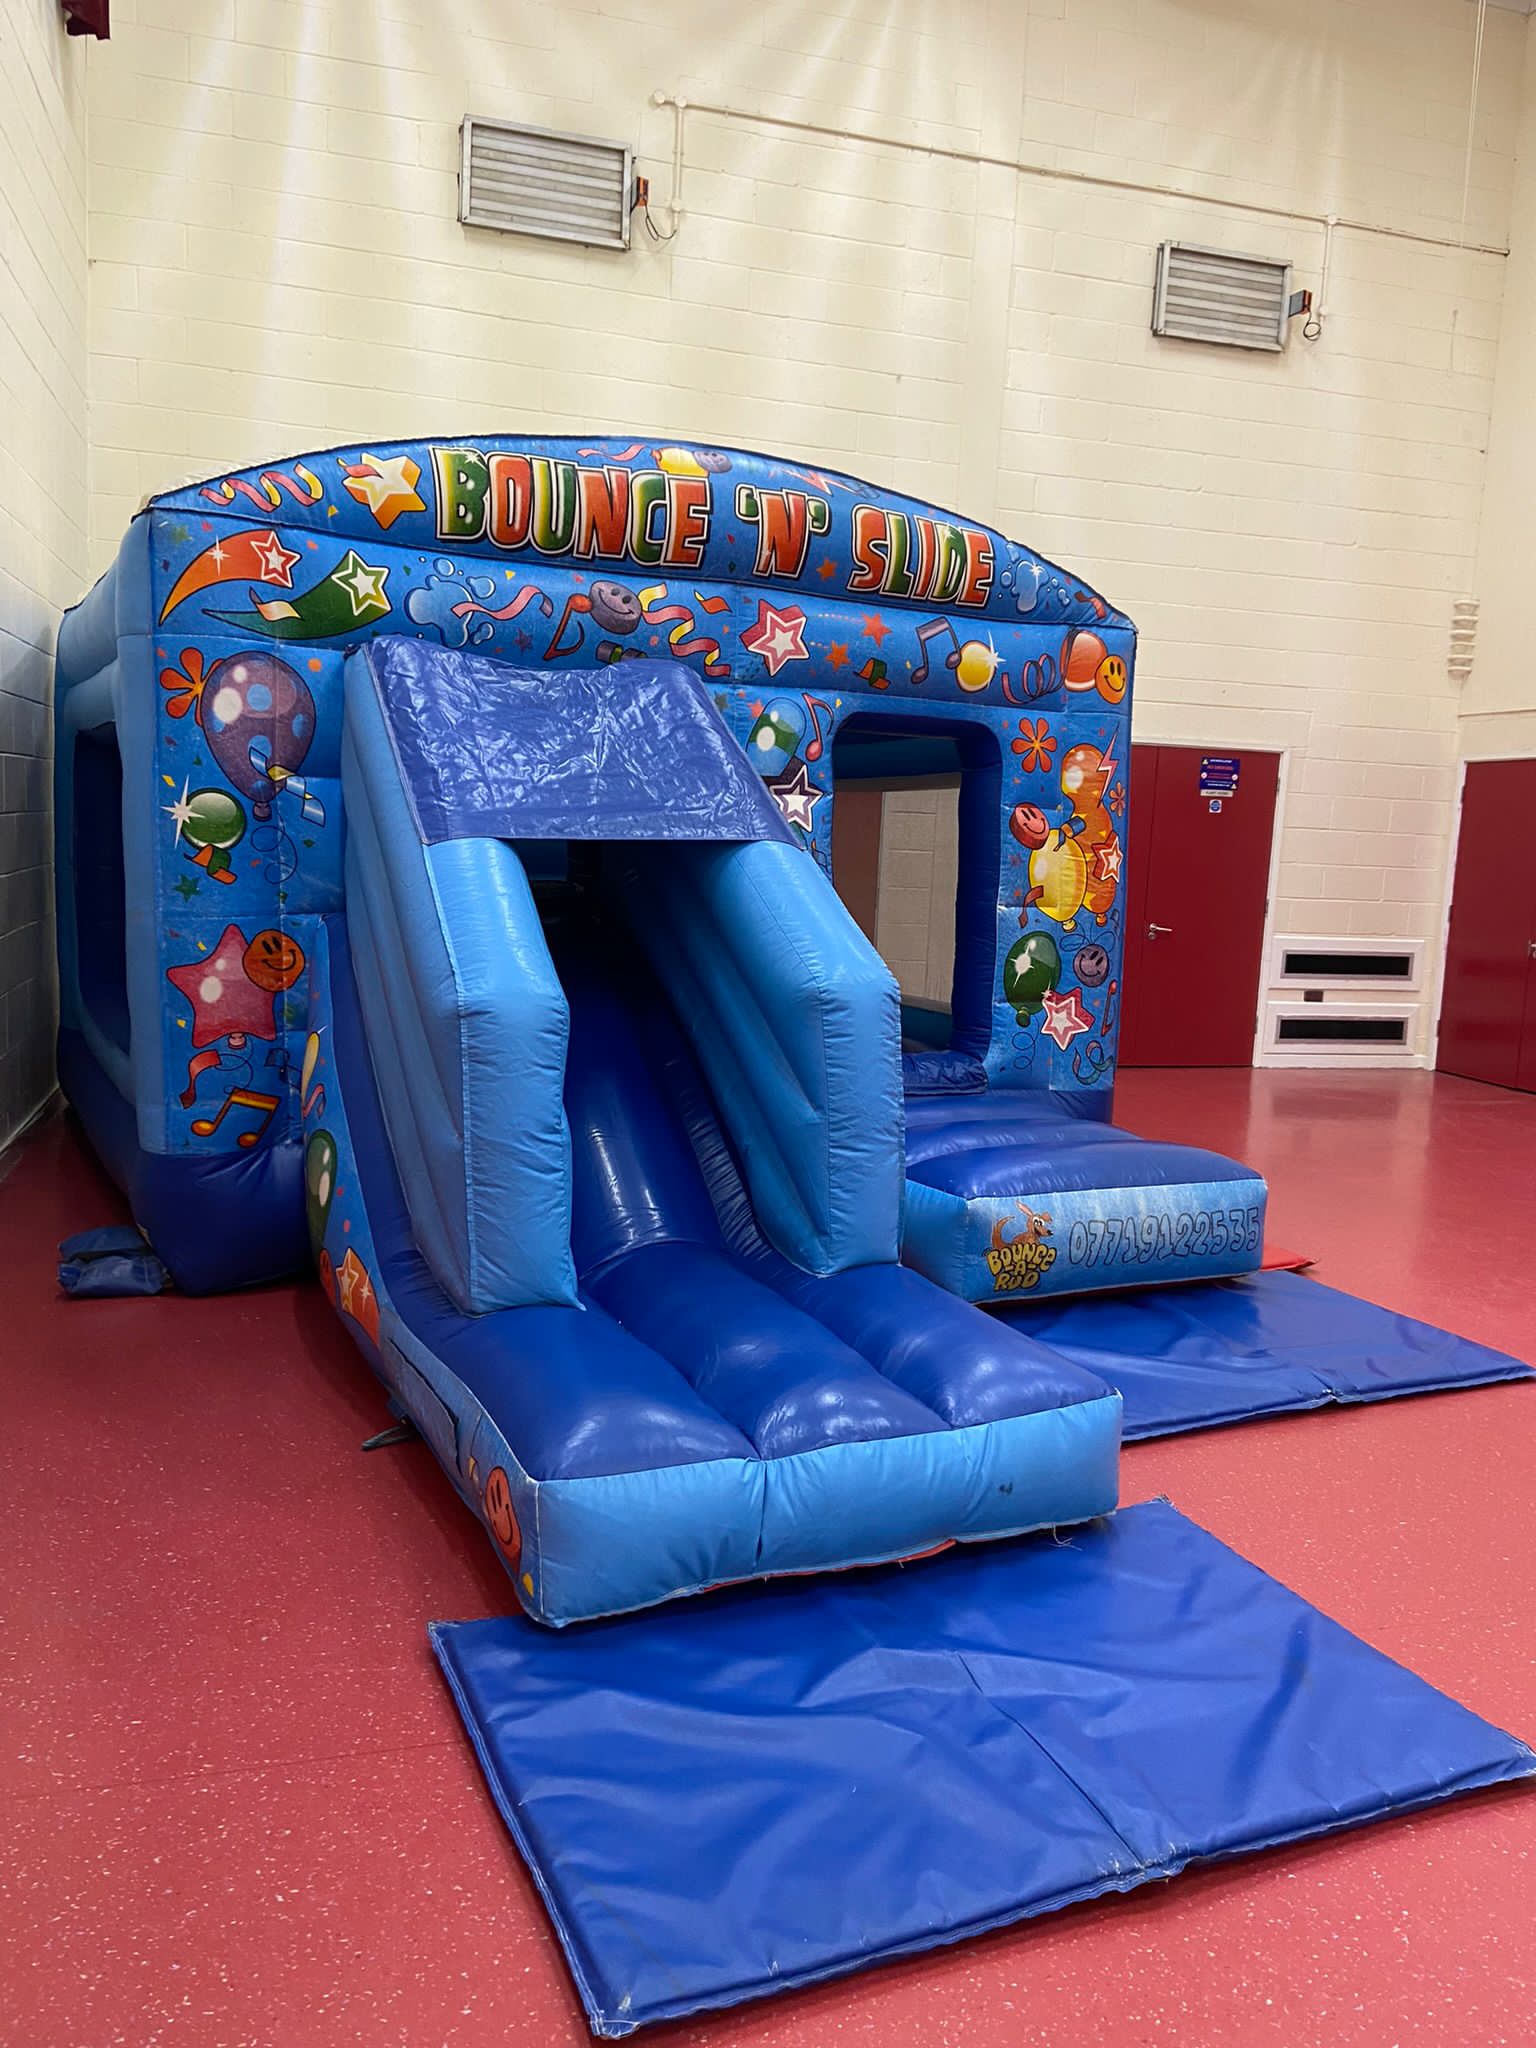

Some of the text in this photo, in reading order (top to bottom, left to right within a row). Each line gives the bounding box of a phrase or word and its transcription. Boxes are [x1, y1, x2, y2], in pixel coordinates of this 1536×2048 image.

[430, 446, 710, 567] BOUNCE
[850, 505, 995, 606] SLIDE
[986, 1244, 1056, 1276] BOUNCE
[1068, 1207, 1260, 1267] 07719122535
